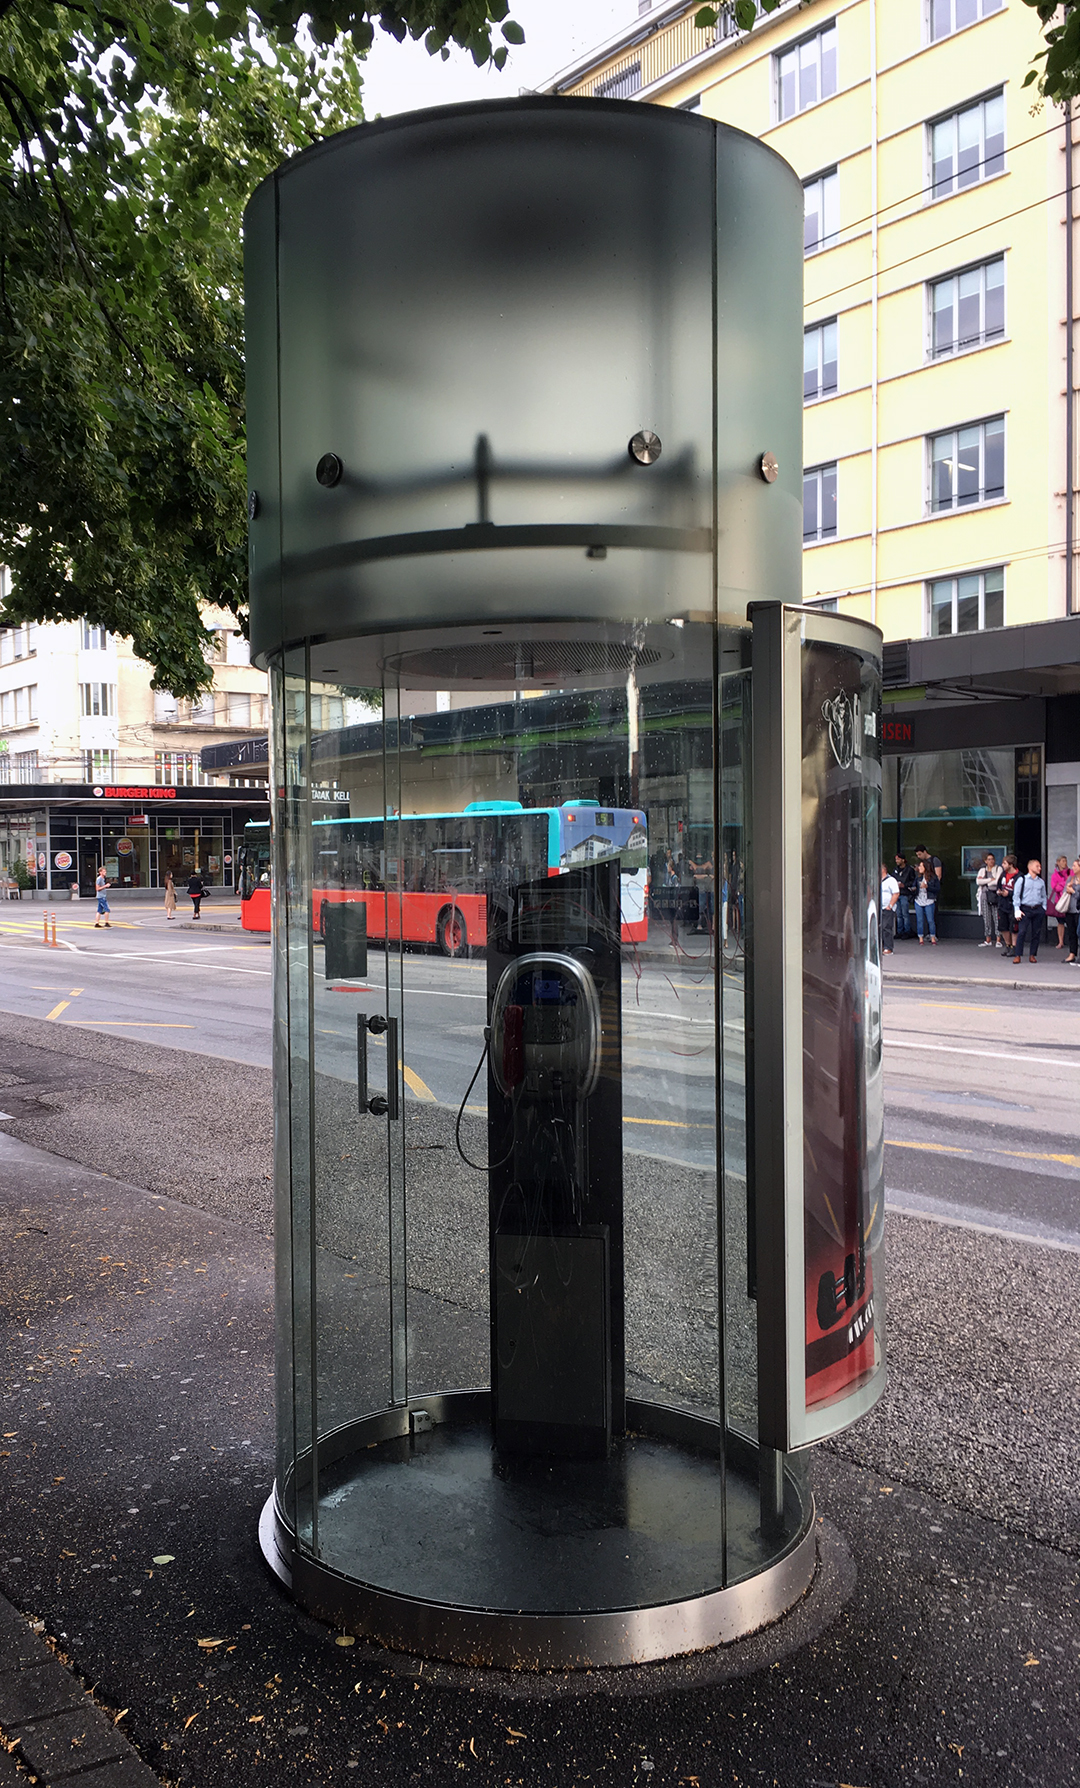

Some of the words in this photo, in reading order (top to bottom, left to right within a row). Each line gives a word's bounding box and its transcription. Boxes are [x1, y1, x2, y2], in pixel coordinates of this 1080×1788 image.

[104, 787, 148, 798] BURGER
[149, 788, 176, 798] KING
[311, 790, 330, 801] TAAK
[600, 813, 607, 823] 5
